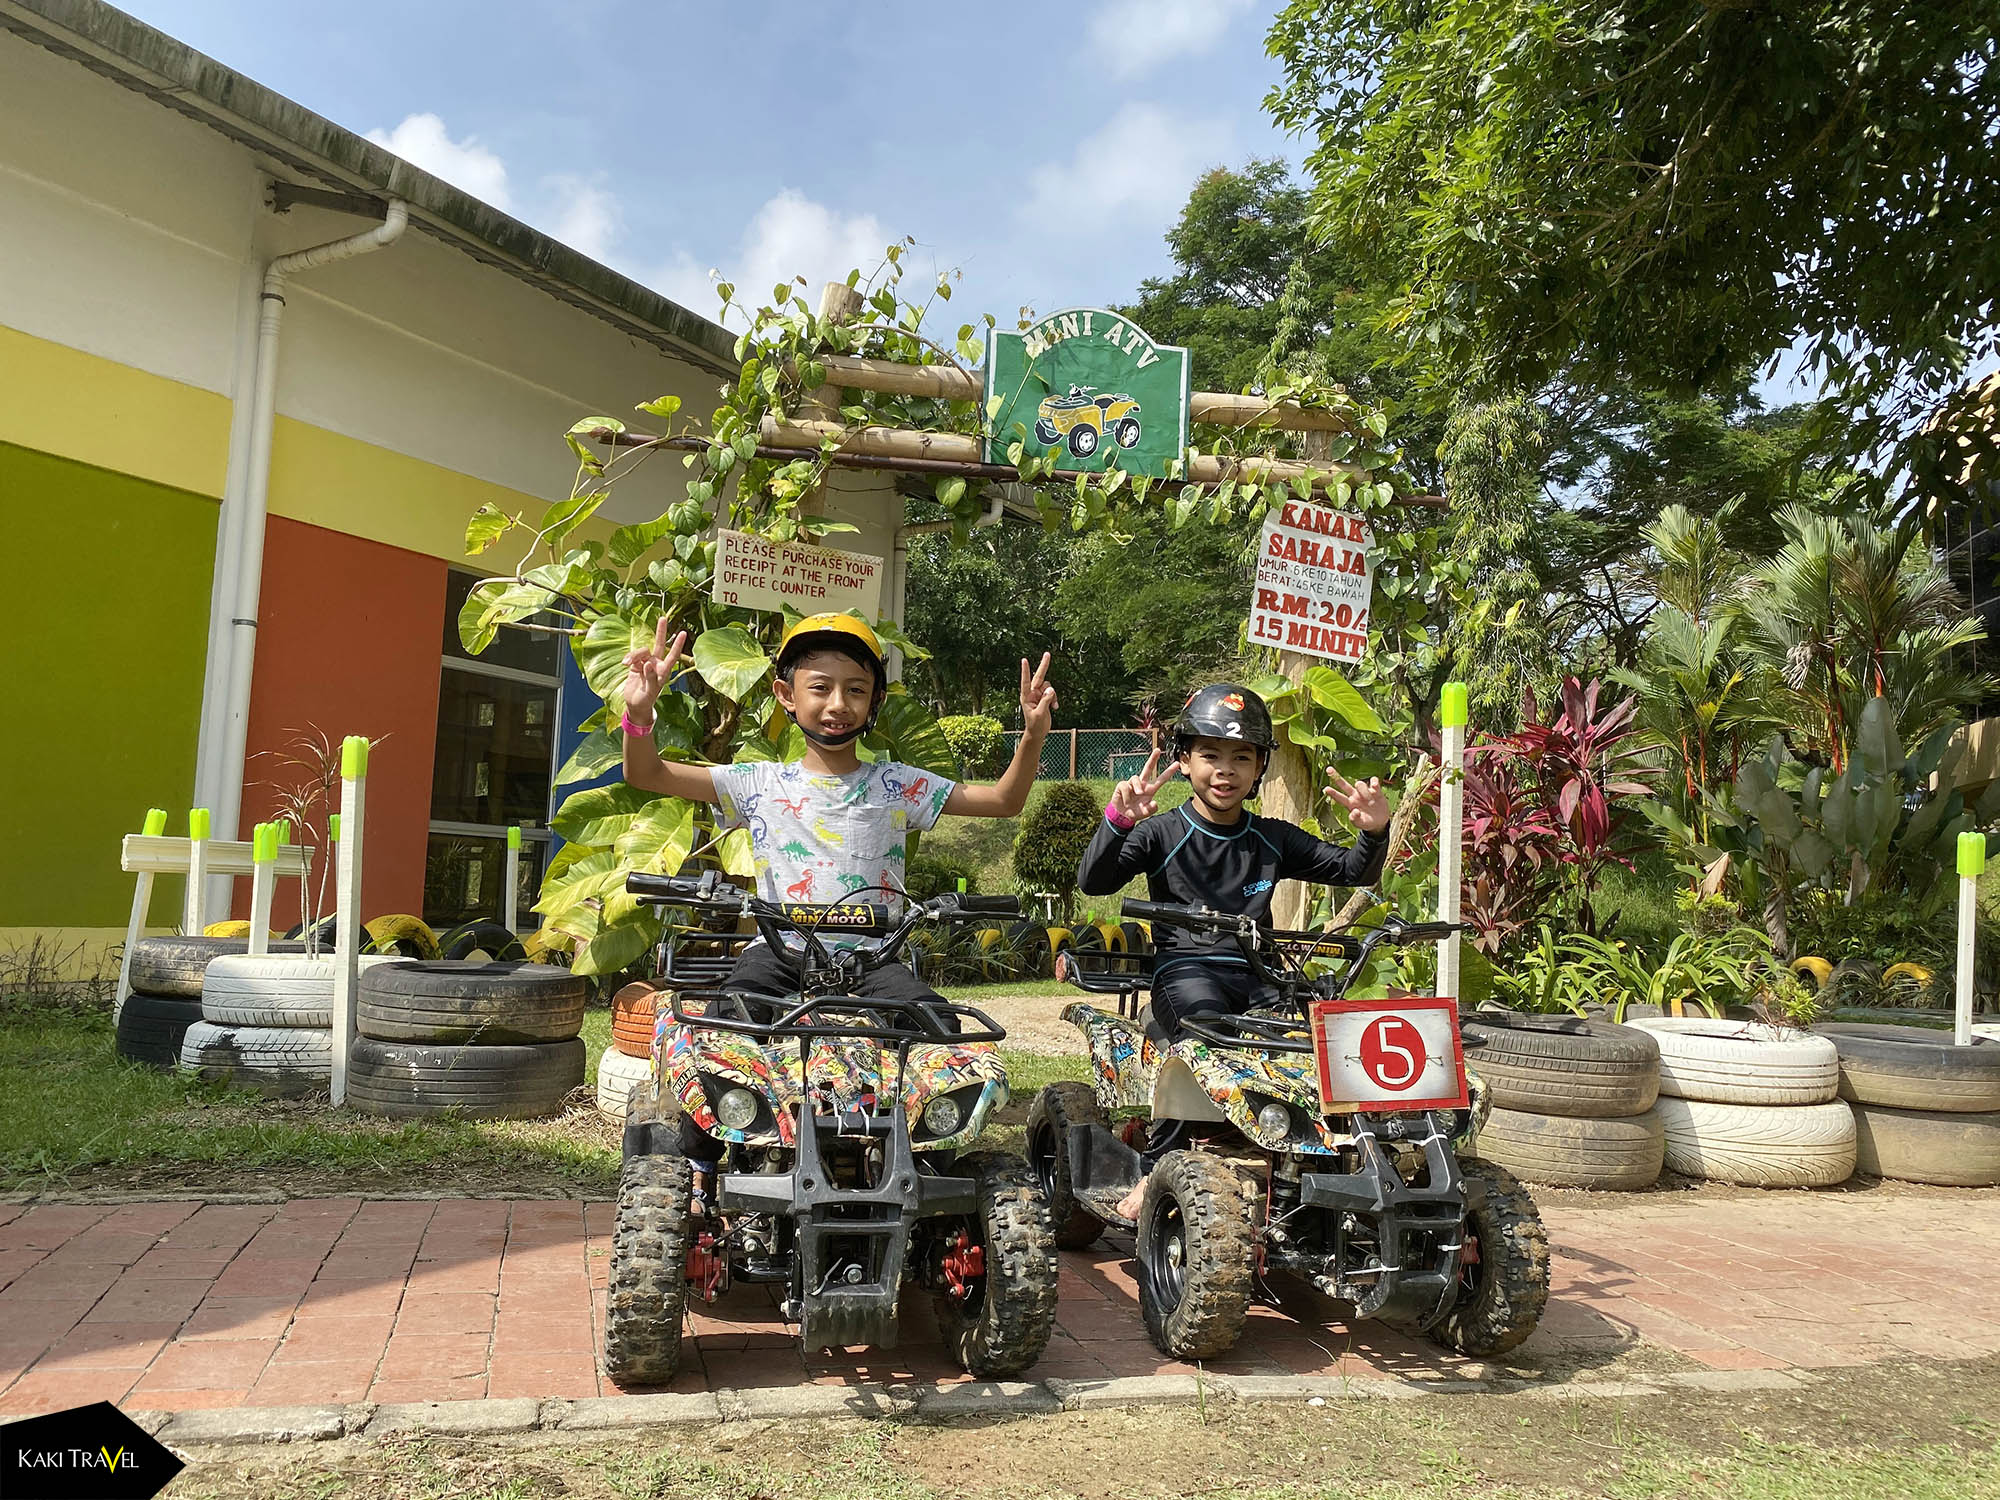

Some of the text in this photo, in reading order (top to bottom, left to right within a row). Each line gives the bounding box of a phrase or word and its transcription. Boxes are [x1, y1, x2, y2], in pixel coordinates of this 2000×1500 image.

[1103, 321, 1160, 369] ATV
[726, 538, 874, 576] PLEASE PURCHASE YOUR
[1268, 533, 1366, 576] SAHAJA
[723, 570, 826, 599] OFFICE COUNTER
[725, 554, 865, 590] RECEIPT AT THE FRONT
[1329, 573, 1362, 588] TAHUN
[723, 591, 738, 605] TQ
[1327, 585, 1365, 600] BAWAH
[1254, 615, 1367, 658] 15 MINIT
[1225, 722, 1243, 739] 2
[792, 915, 867, 924] MIN MOTO
[1376, 1021, 1414, 1085] 5
